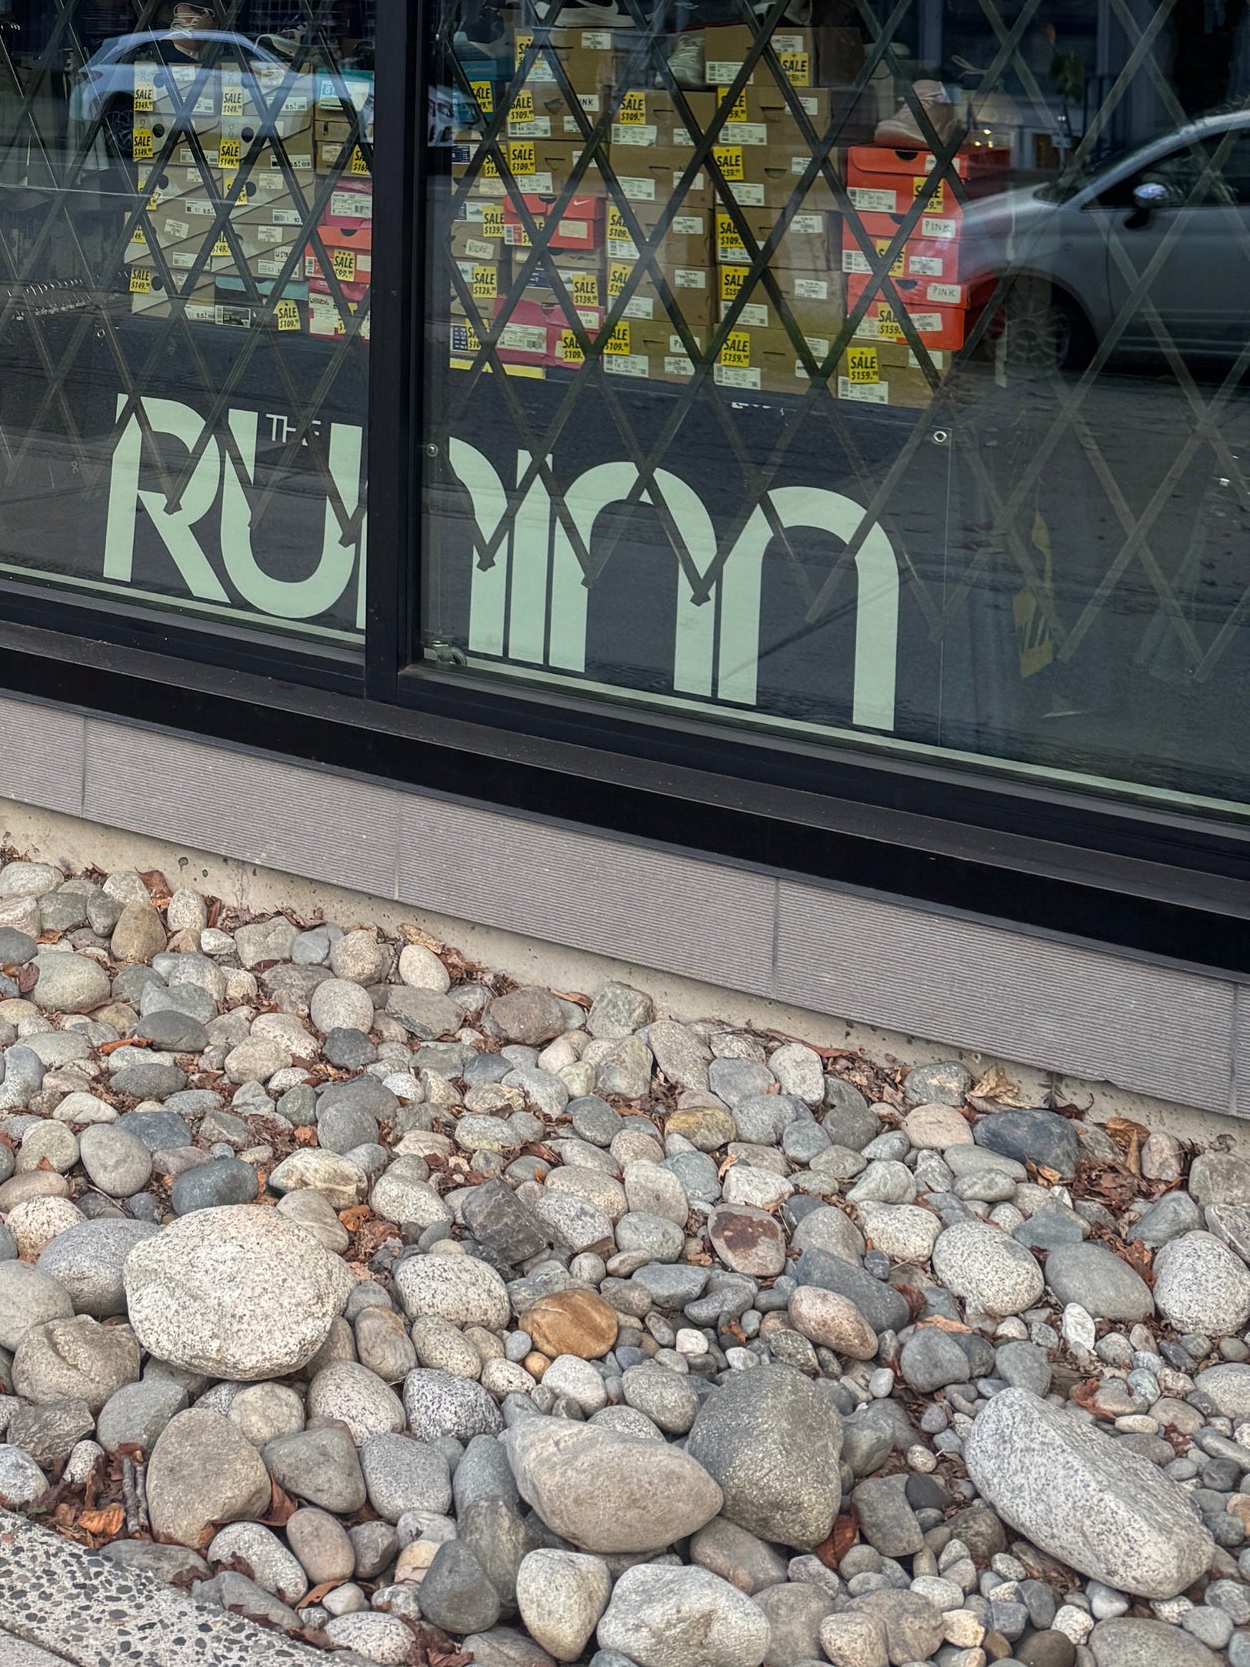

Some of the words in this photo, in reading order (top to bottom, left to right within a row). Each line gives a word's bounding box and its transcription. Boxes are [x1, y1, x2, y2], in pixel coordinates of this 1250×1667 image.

[783, 60, 807, 72] SALE
[135, 89, 153, 100] SALE
[223, 92, 242, 104] SALE
[512, 96, 532, 109] SALE
[620, 98, 644, 111] SALE
[134, 136, 151, 147] SALE
[222, 146, 240, 157] SALE
[512, 148, 533, 161] SALE
[718, 156, 741, 167] SALE
[720, 222, 738, 234] SAL
[926, 220, 950, 233] PINK
[721, 236, 741, 245] $109.
[334, 256, 354, 269] SALE
[132, 270, 150, 281] SALE
[474, 273, 495, 285] SALE
[611, 270, 627, 283] SAL
[724, 274, 745, 286] SAL
[574, 282, 596, 294] SALE
[933, 286, 955, 297] PINK
[278, 307, 297, 319] SALE
[612, 329, 628, 341] ALE
[880, 325, 902, 335] $159.
[563, 338, 580, 349] SAL
[724, 339, 749, 352] SALE
[851, 356, 876, 369] SALE
